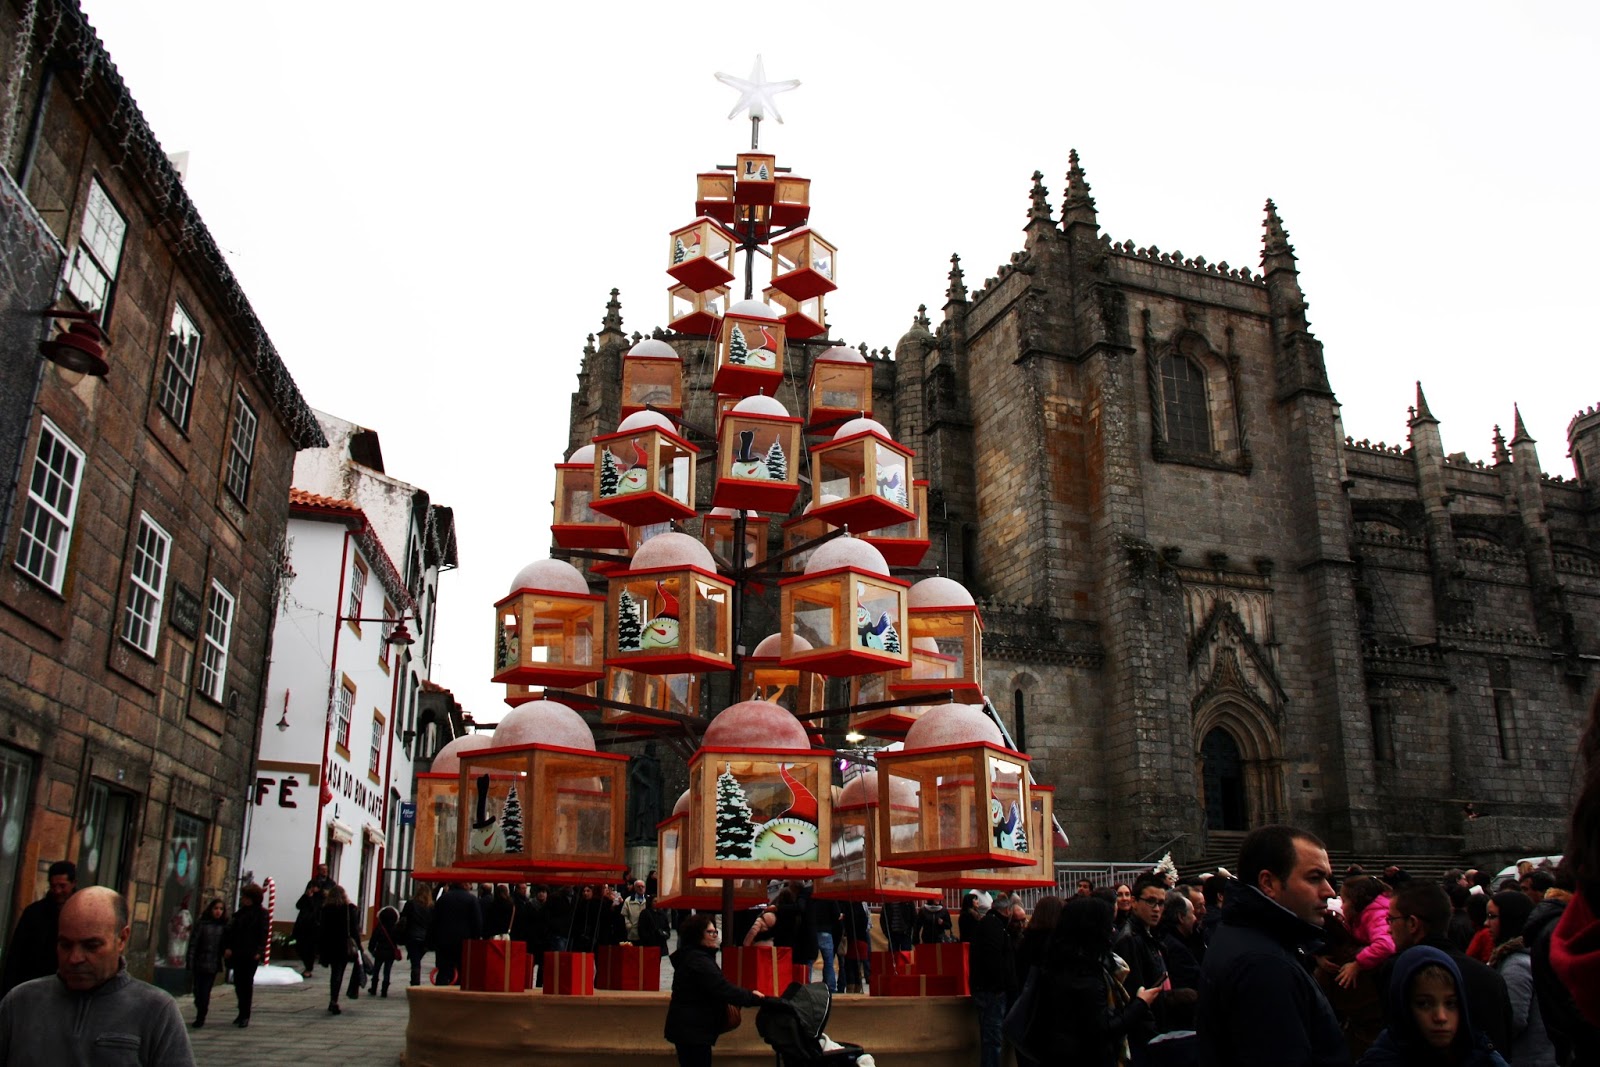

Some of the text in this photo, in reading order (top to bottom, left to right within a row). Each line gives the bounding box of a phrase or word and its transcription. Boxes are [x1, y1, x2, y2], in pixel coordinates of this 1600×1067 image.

[344, 771, 353, 799] DO
[354, 778, 367, 810] BOM
[368, 790, 383, 821] CAFÉ
